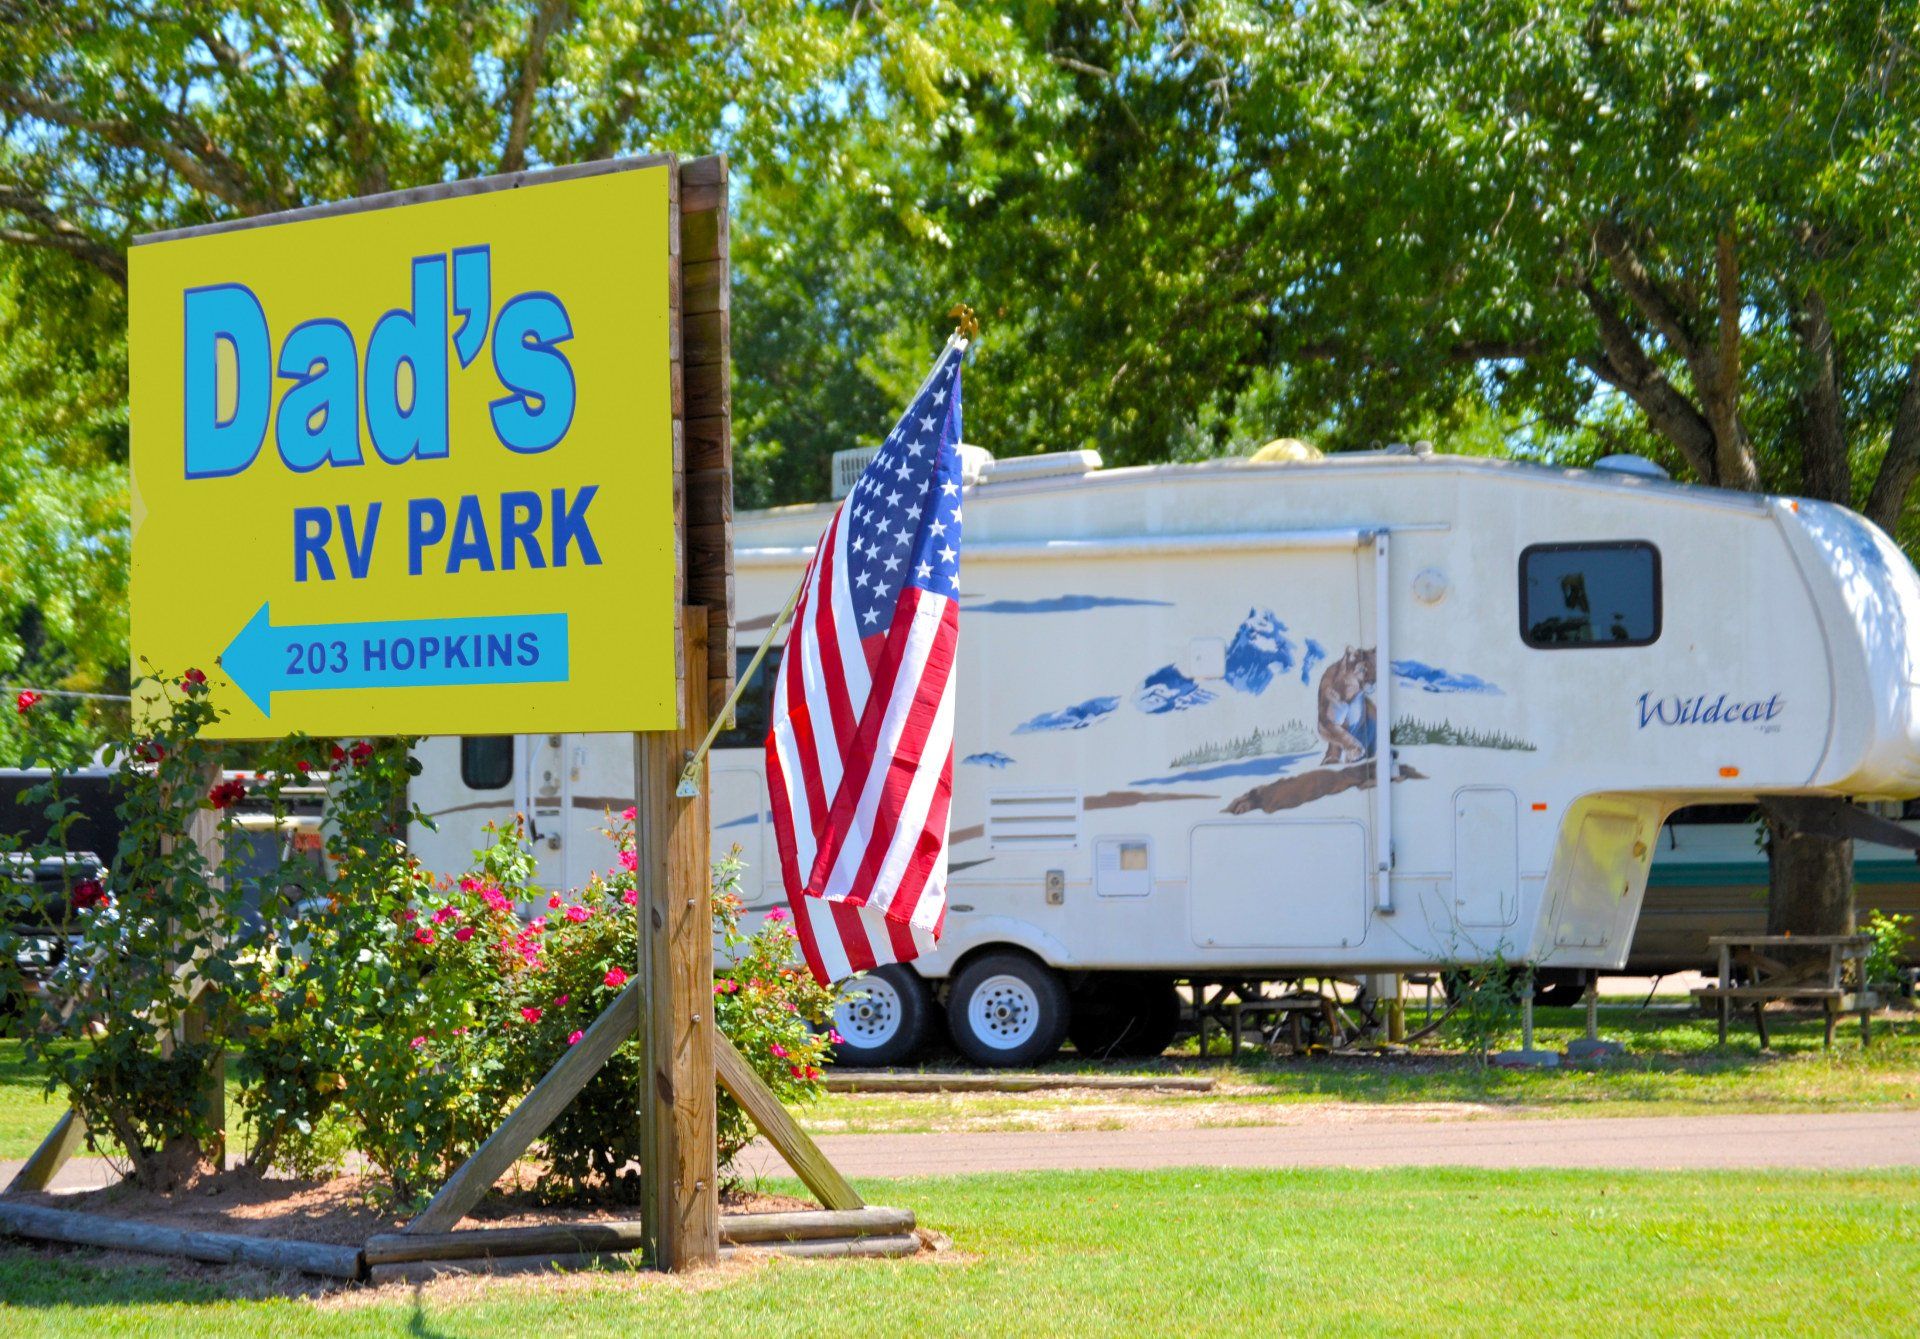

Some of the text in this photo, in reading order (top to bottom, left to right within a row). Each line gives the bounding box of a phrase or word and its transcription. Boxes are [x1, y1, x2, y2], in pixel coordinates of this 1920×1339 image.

[183, 243, 576, 480] Dad's
[293, 485, 603, 582] RV PARK
[285, 631, 540, 675] 203 HOPKINS
[1637, 690, 1785, 729] Wildcat
